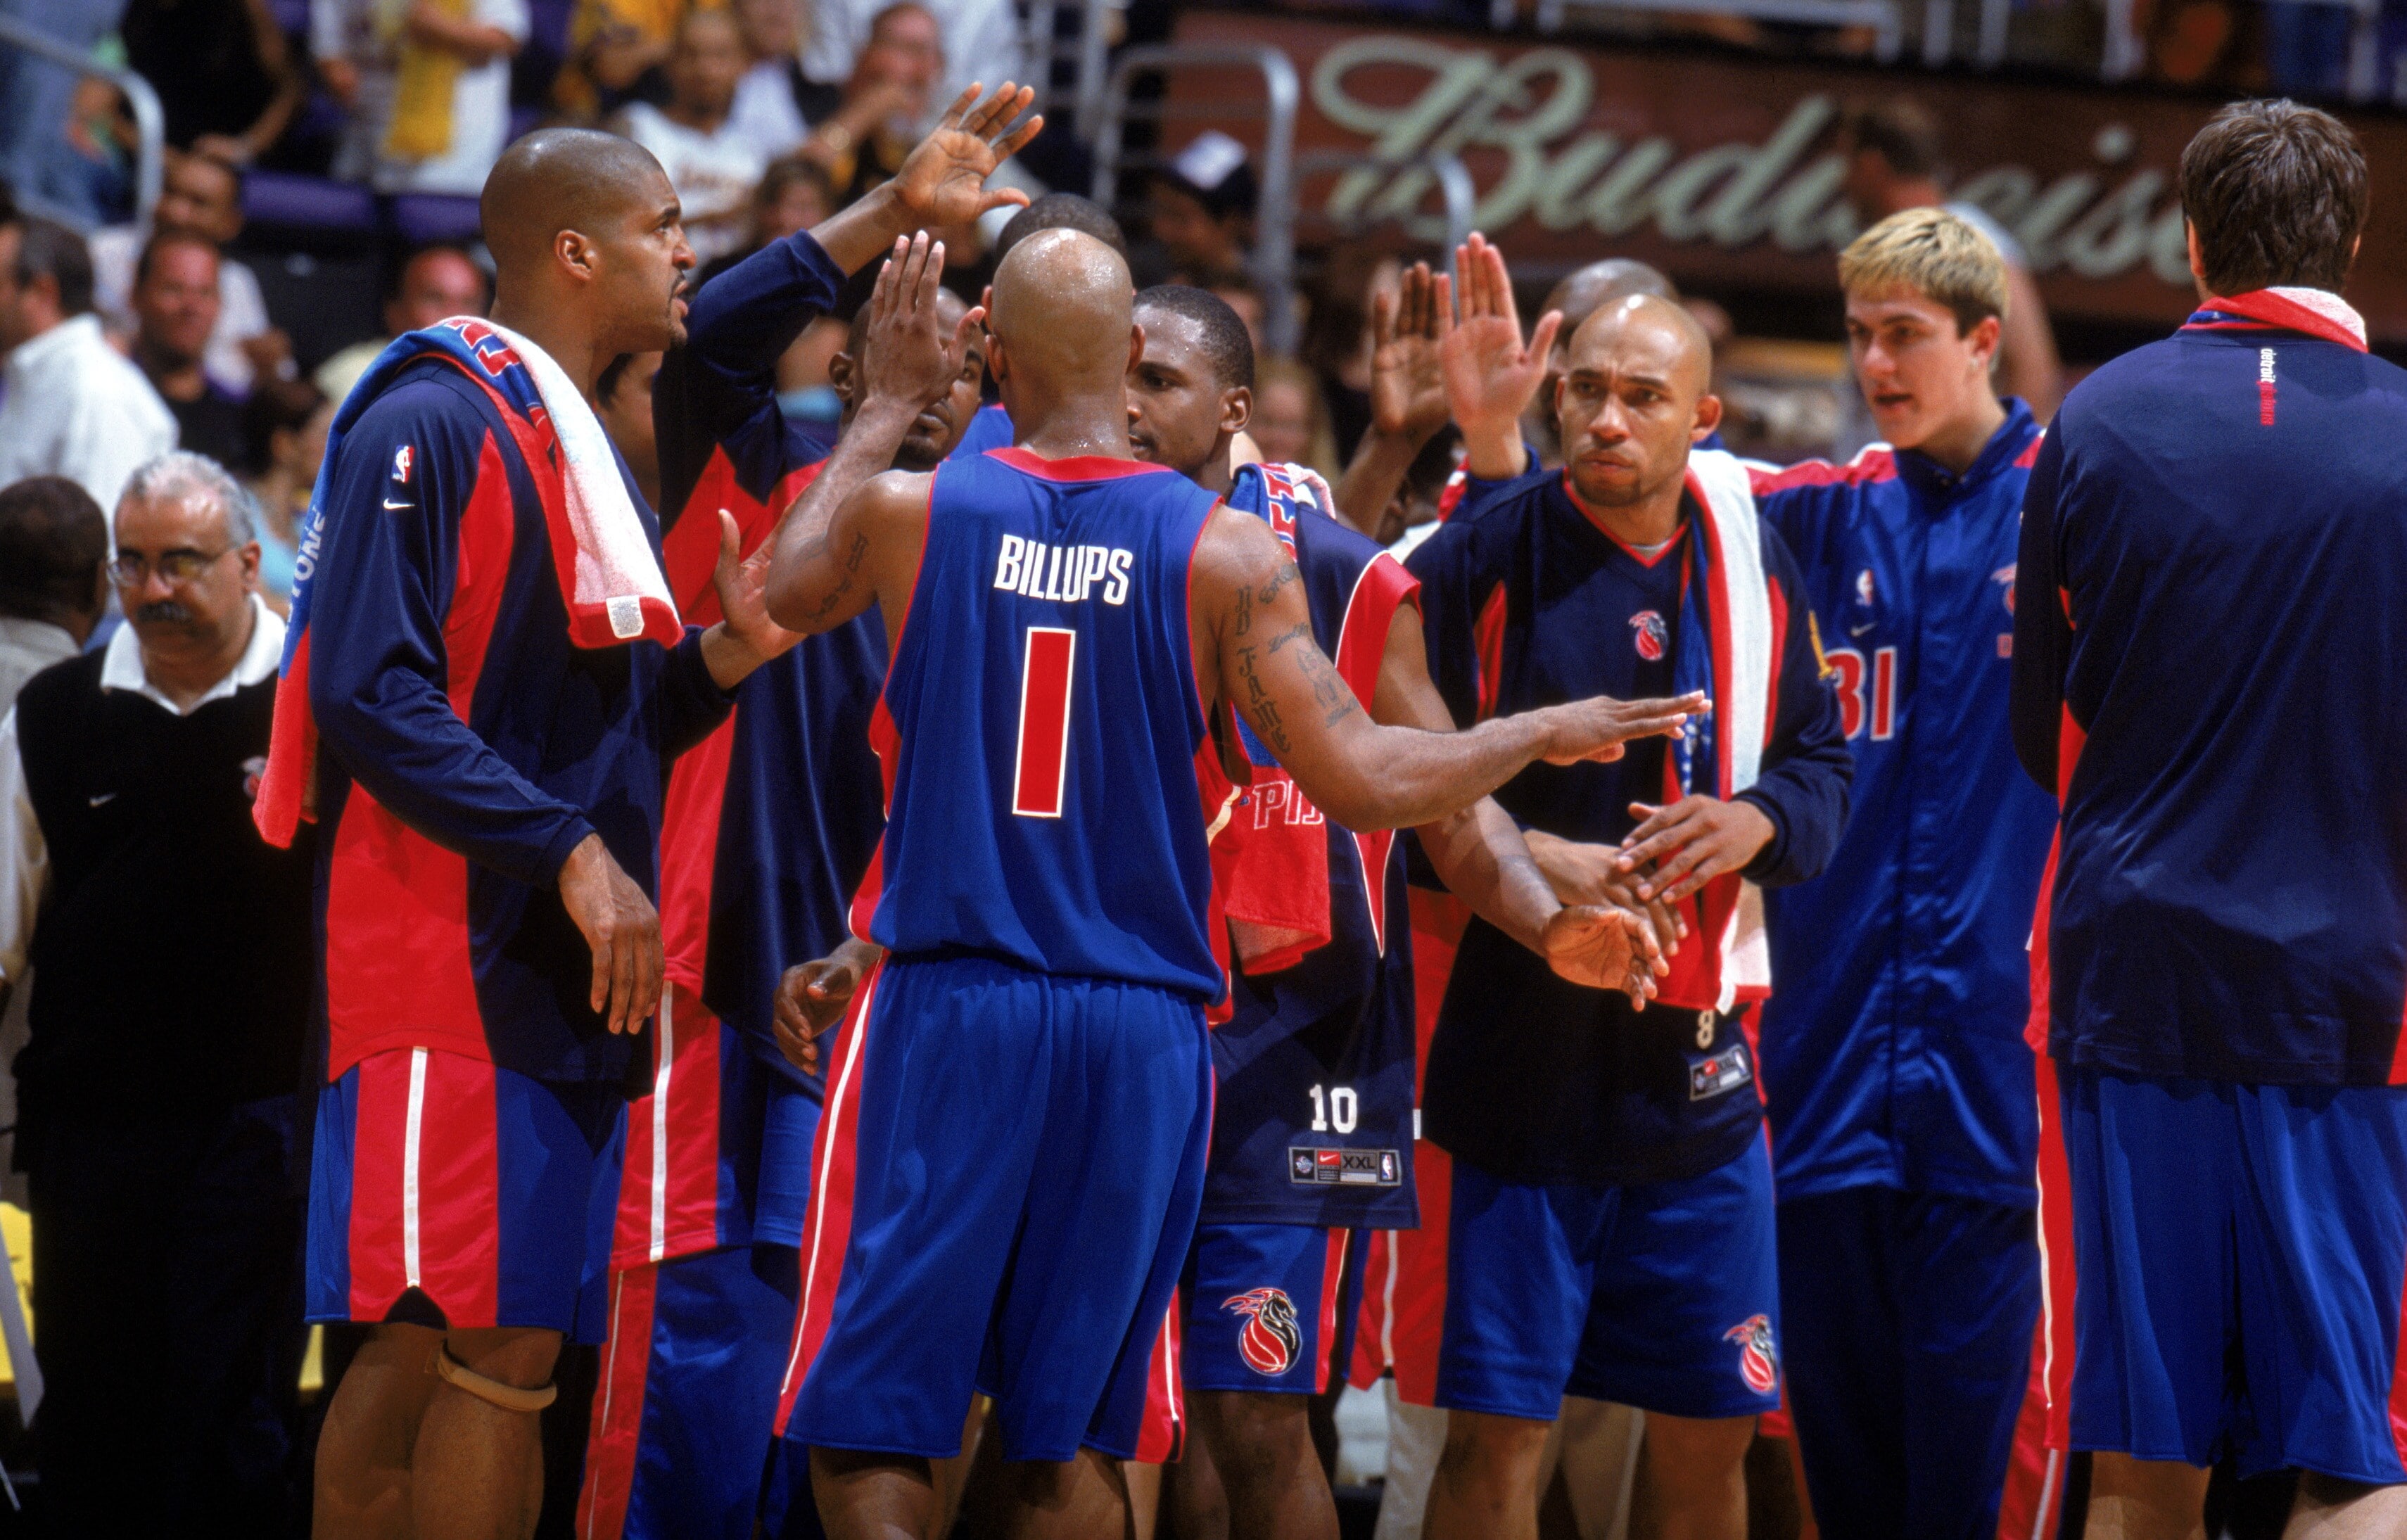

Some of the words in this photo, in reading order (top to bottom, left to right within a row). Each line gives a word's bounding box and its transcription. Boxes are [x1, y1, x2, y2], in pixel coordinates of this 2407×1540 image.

[993, 534, 1133, 606] BILLUPS
[1012, 626, 1077, 817] 1
[1696, 1010, 1715, 1049] 8
[1309, 1084, 1357, 1133] 10
[1343, 1156, 1376, 1169] XXL
